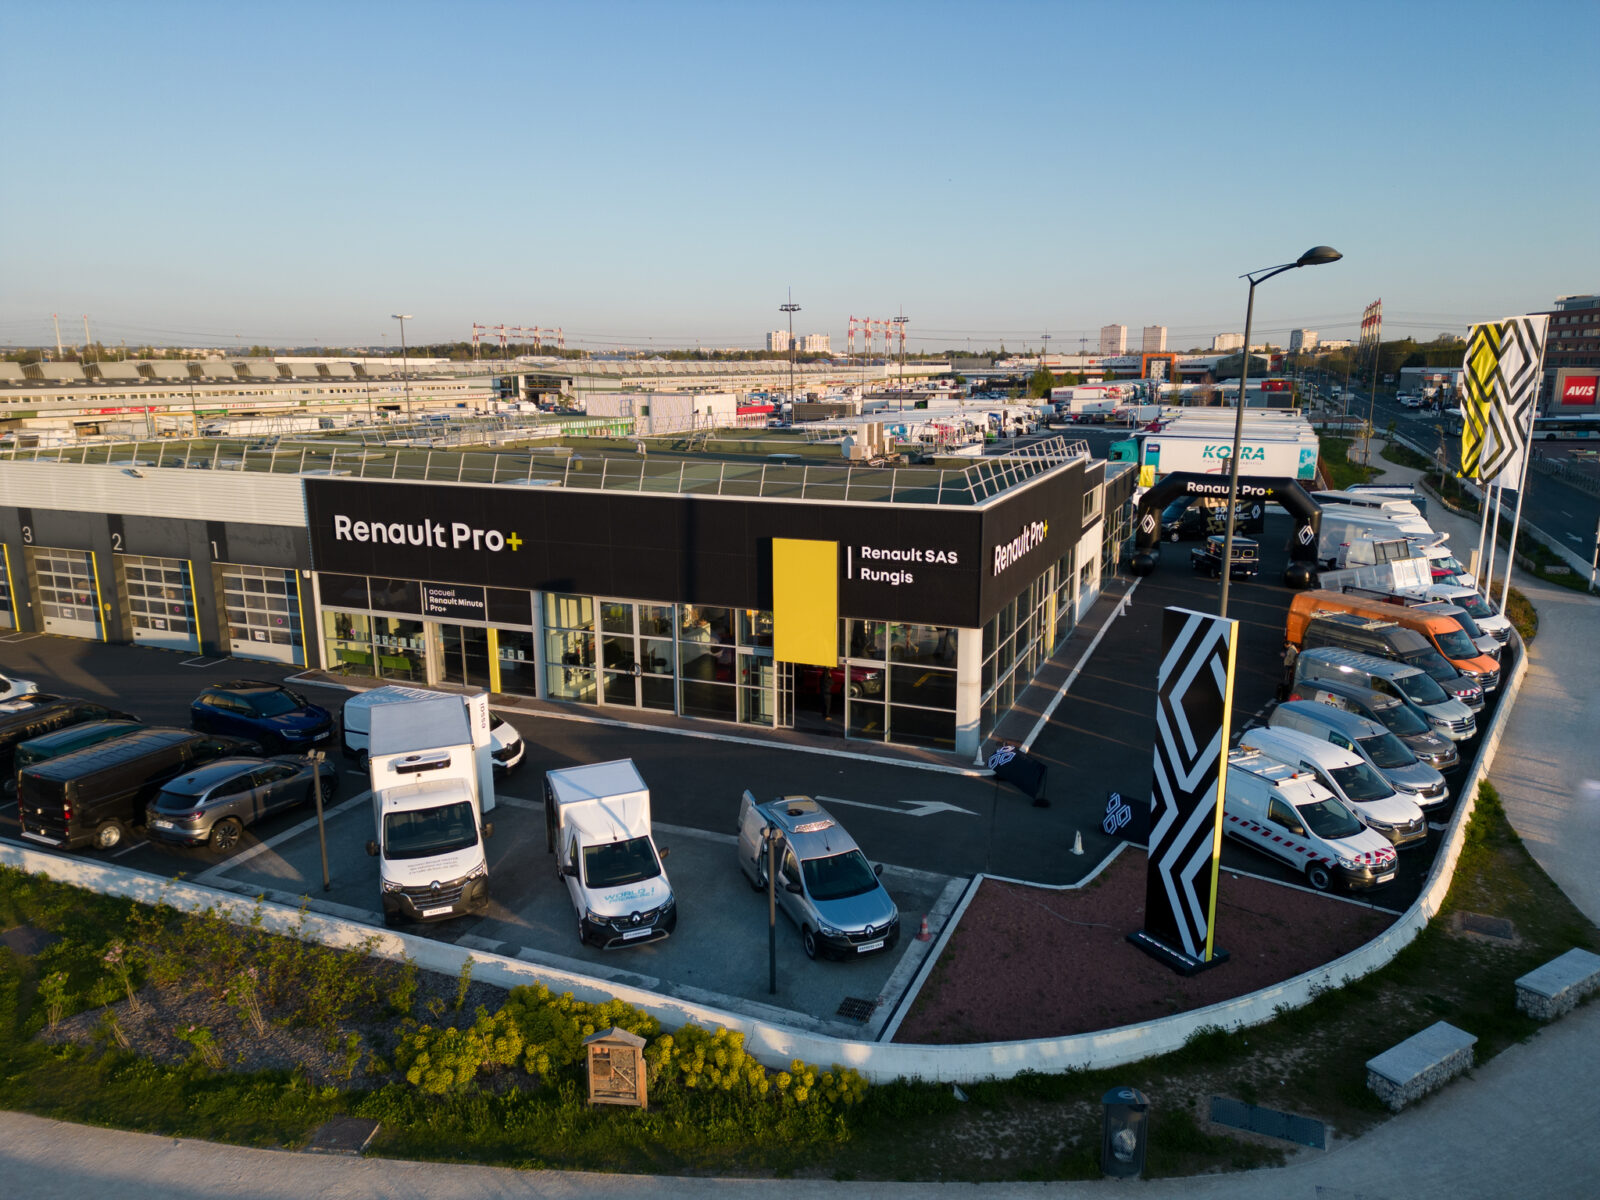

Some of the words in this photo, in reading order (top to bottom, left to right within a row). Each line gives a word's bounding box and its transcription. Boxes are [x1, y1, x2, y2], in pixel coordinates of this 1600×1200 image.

[1566, 386, 1595, 396] AVIS
[1202, 445, 1265, 460] KORA
[1242, 485, 1274, 496] Pro+
[22, 526, 33, 543] 3
[334, 514, 447, 548] Renault
[451, 522, 523, 552] Pro+
[111, 533, 123, 551] 2
[210, 540, 218, 559] 1
[994, 525, 1030, 576] Renault
[1030, 520, 1049, 549] Pro+
[861, 546, 922, 562] Renault
[925, 550, 958, 564] SAS
[861, 568, 914, 585] Rungis
[429, 589, 455, 597] accueil
[429, 597, 457, 606] Renault
[458, 599, 484, 608] Minute
[430, 605, 447, 613] Pro+
